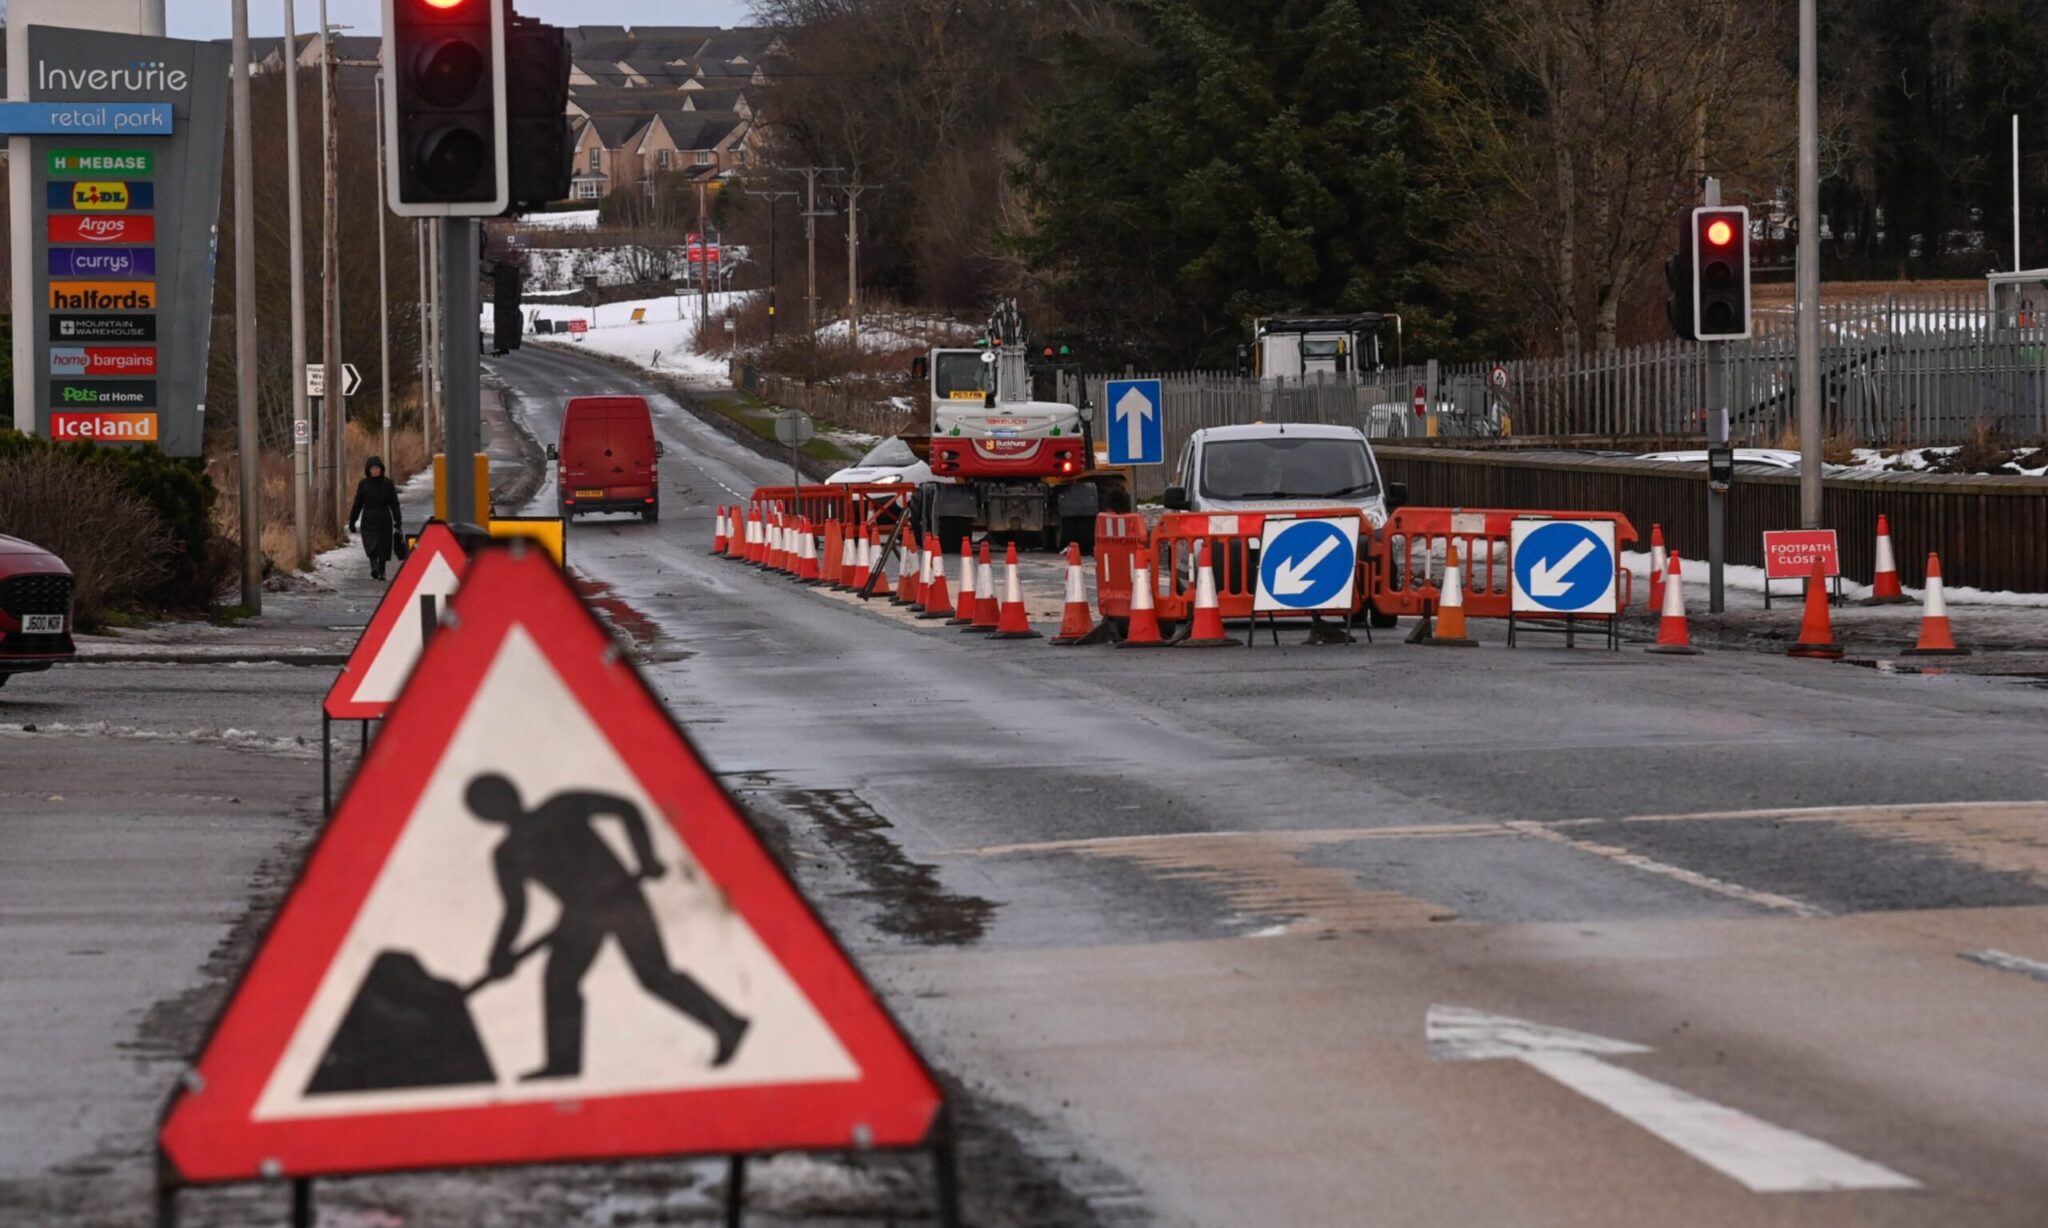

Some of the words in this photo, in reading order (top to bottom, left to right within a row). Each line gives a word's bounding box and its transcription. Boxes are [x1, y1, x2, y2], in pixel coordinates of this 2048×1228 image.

[39, 60, 188, 91] Inverurie
[51, 109, 106, 127] retail
[114, 109, 163, 130] park
[79, 217, 125, 234] Argos
[76, 255, 129, 271] currys
[54, 291, 150, 310] halfords
[75, 320, 133, 328] MOUNTAIN
[76, 328, 145, 336] WAREHOUSE
[53, 354, 87, 366] home
[93, 354, 153, 368] bargains
[62, 387, 98, 402] Pets
[99, 392, 111, 402] at
[112, 392, 144, 402] Home
[58, 417, 150, 437] Iceland
[1771, 543, 1832, 553] FOOTPATH
